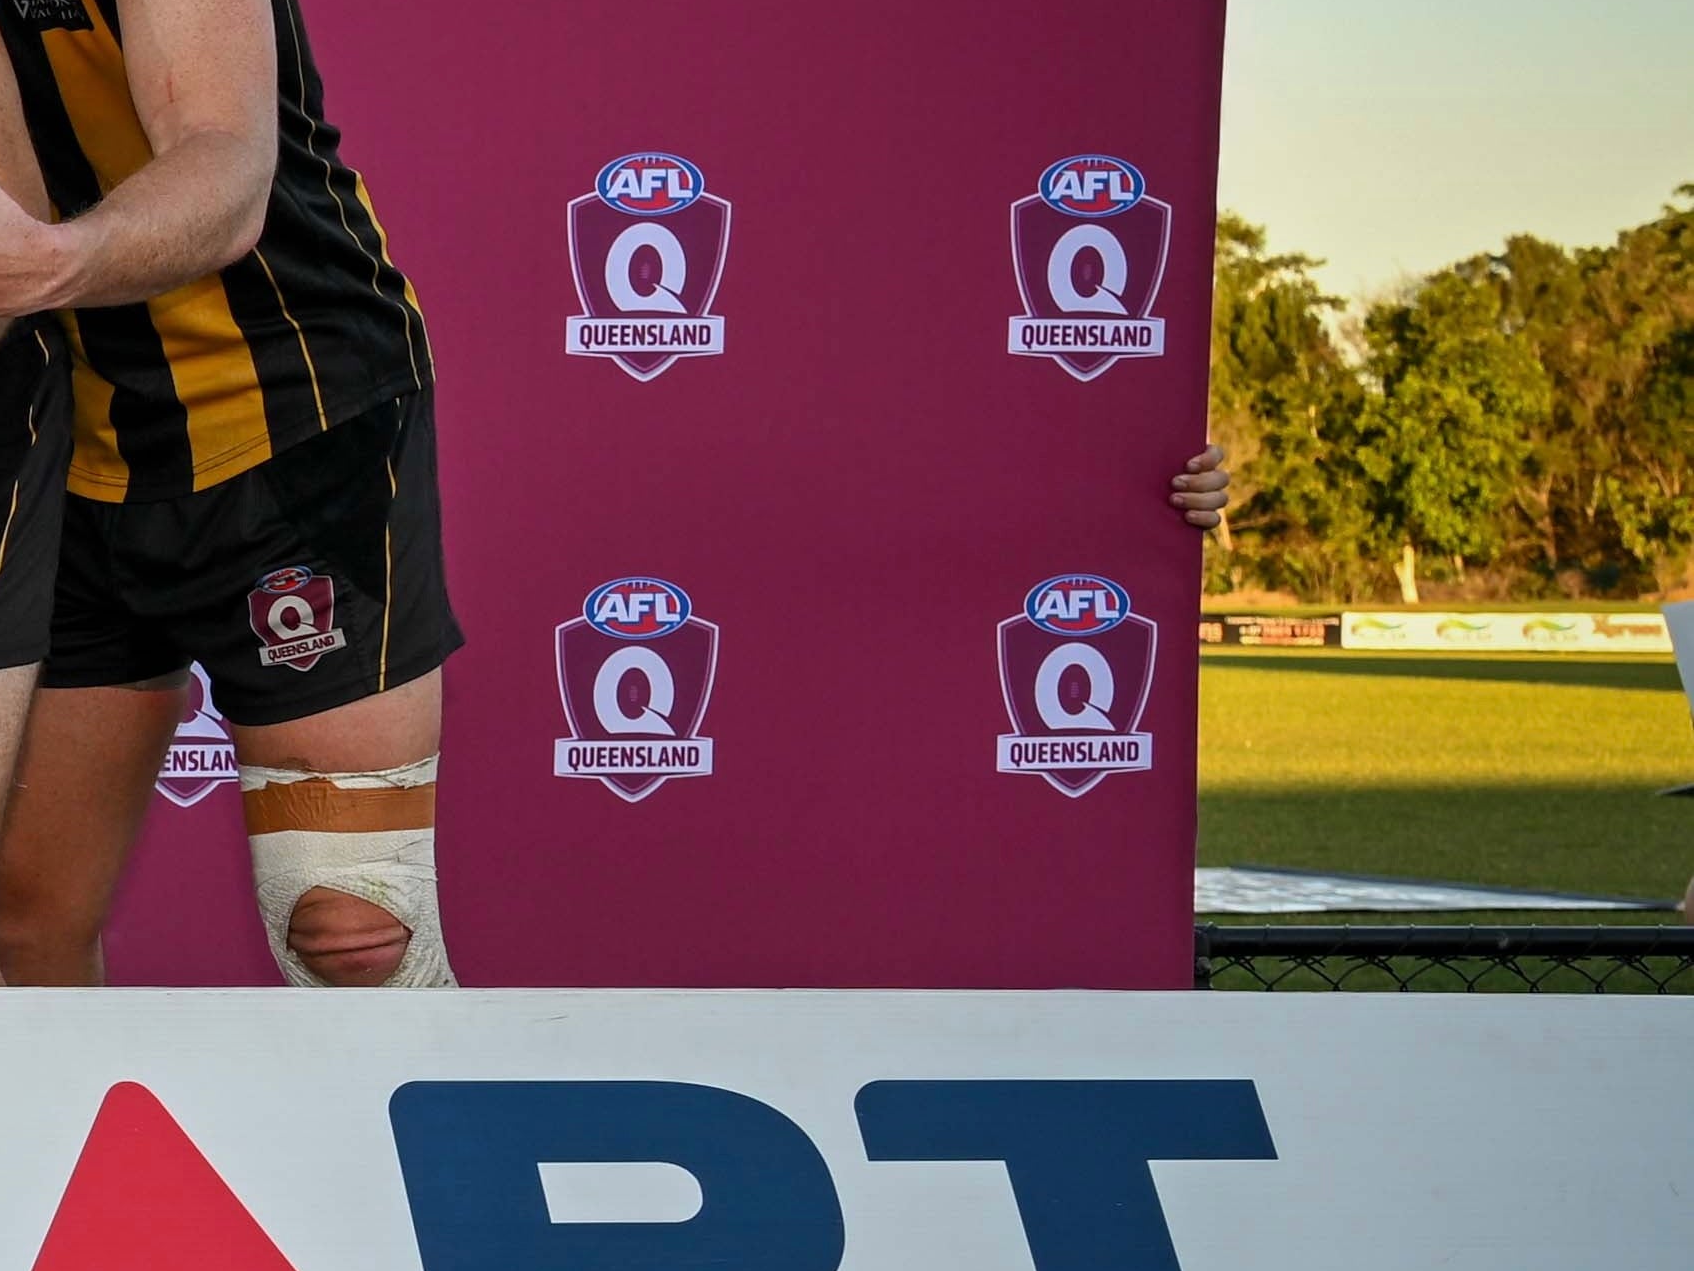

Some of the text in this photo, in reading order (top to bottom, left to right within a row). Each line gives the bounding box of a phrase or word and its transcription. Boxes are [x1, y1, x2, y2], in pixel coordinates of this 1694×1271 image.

[606, 166, 696, 201] AFL
[1051, 169, 1136, 203] AFL
[605, 221, 689, 314] Q
[1047, 222, 1127, 315] Q
[578, 322, 712, 350] QUEENSLAND
[1020, 323, 1152, 349] QUEENSLAND
[268, 595, 318, 640] Q
[594, 591, 683, 627] AFL
[1036, 588, 1120, 624] AFL
[268, 634, 336, 662] QUEENSLAND
[592, 644, 677, 735] Q
[1034, 642, 1115, 732] Q
[567, 742, 700, 771] QUEENSLAND
[1010, 740, 1139, 767] QUEENSLAND
